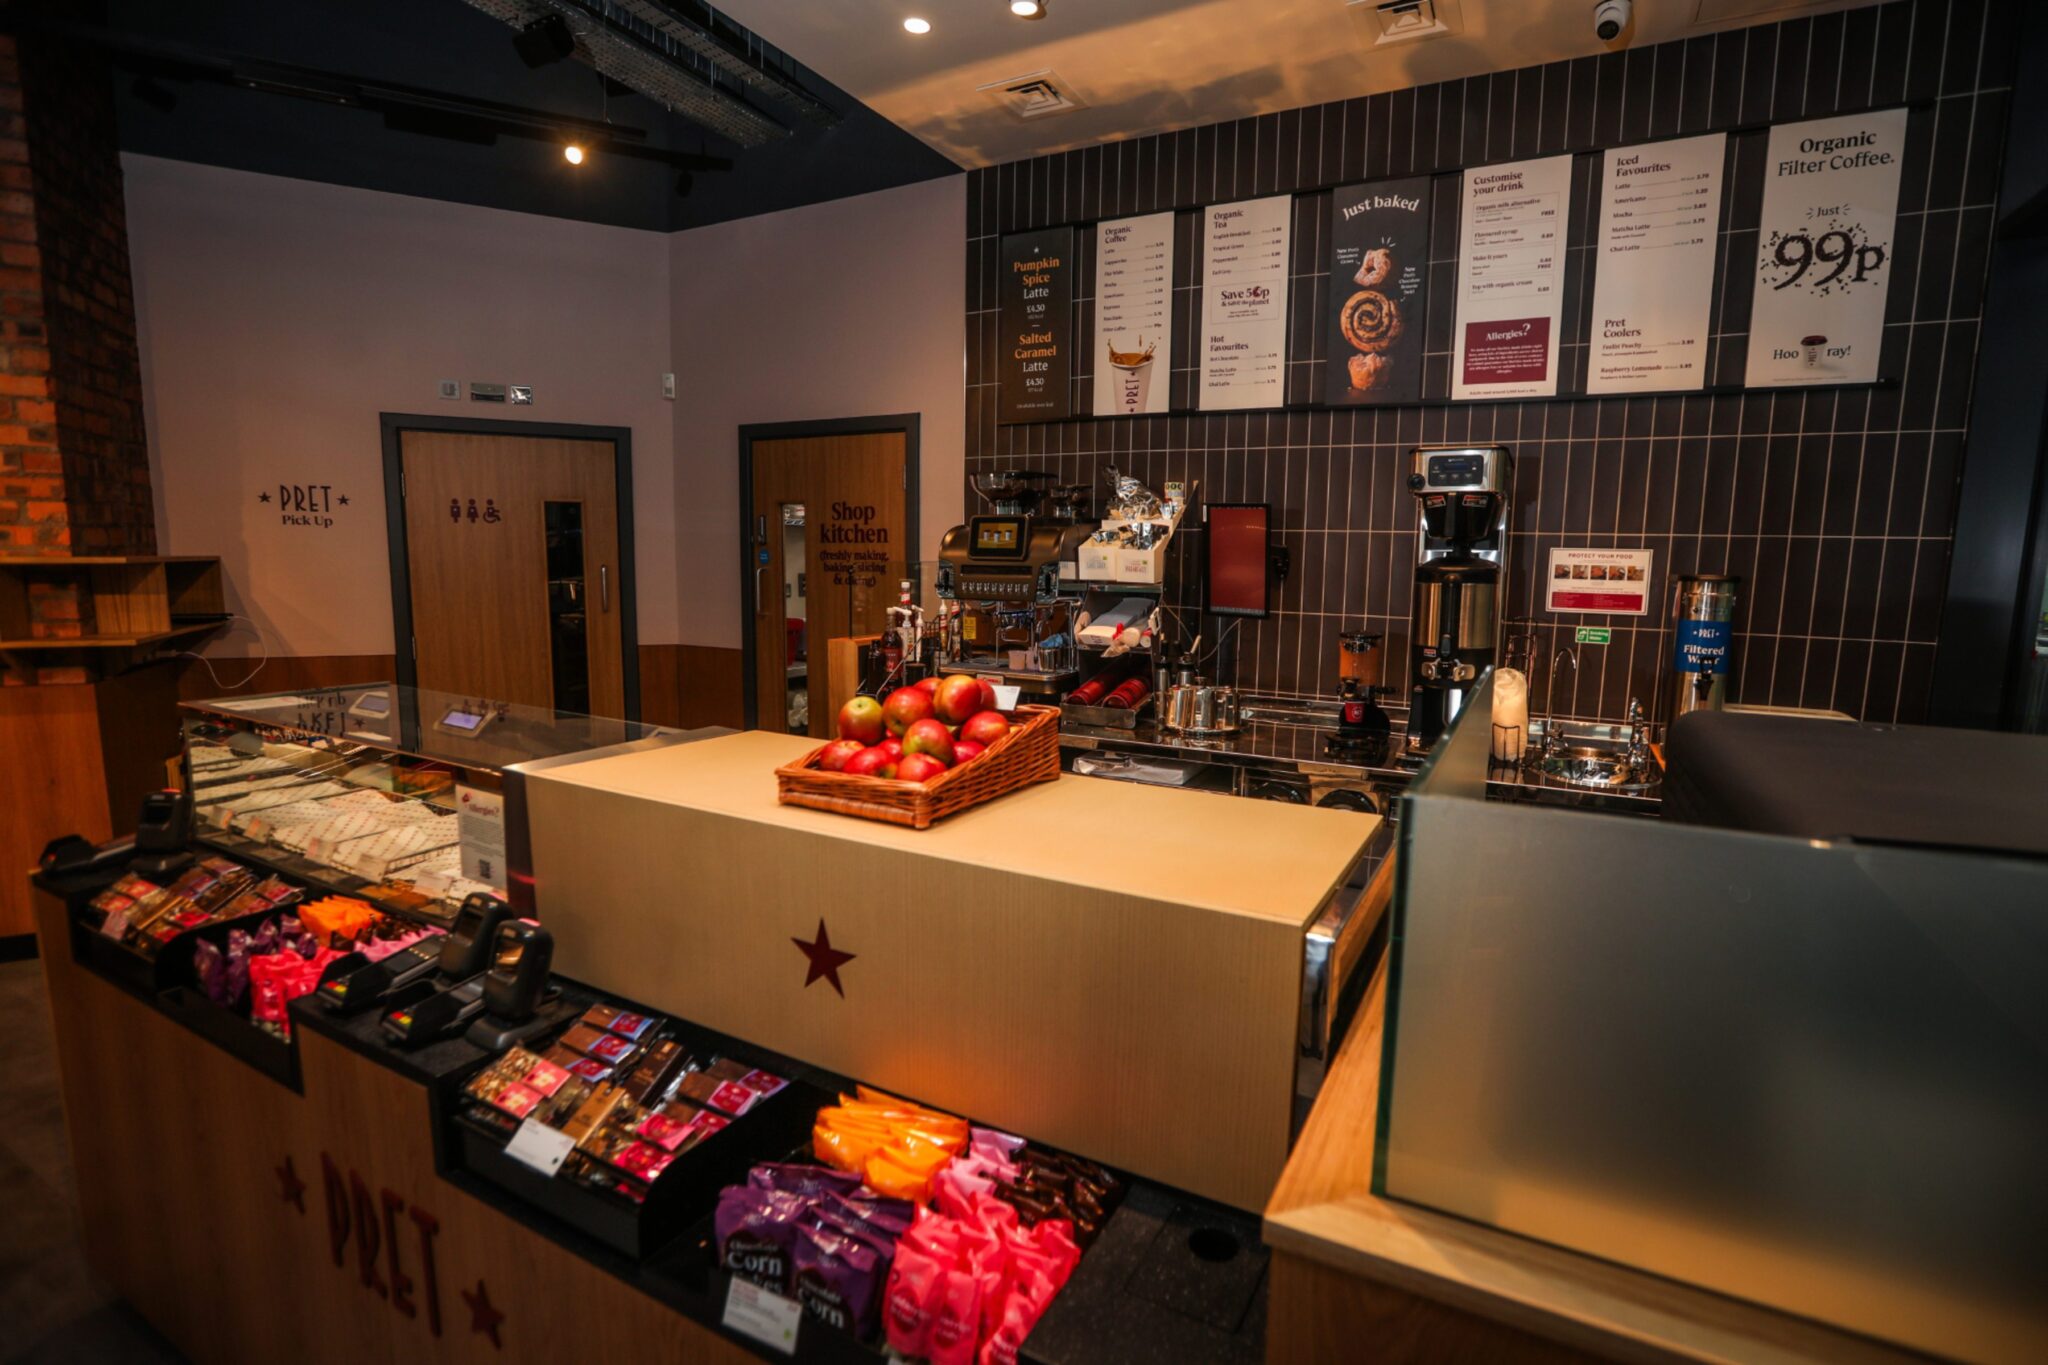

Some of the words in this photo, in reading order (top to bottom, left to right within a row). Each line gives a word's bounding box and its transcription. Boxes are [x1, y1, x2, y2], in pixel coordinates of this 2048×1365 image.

[1800, 131, 1877, 154] Organic
[1617, 155, 1639, 166] Iced
[1778, 159, 1826, 176] Filter
[1830, 152, 1896, 170] Coffee.
[1616, 163, 1672, 177] Favourites
[1473, 171, 1523, 185] Customise
[1473, 186, 1496, 198] your
[1497, 181, 1524, 192] drink
[1214, 209, 1244, 220] Organic
[1342, 198, 1372, 221] Just
[1374, 194, 1420, 212] baked
[1816, 205, 1840, 218] Just
[1105, 225, 1132, 236] Organic
[1214, 221, 1227, 229] Tea
[1105, 235, 1127, 244] Coffee
[1013, 256, 1060, 273] Pumpkin
[1774, 230, 1885, 291] 99p
[1022, 272, 1050, 287] Spice
[1023, 287, 1049, 300] Latte
[1221, 289, 1244, 300] Save
[1605, 319, 1625, 328] Pret
[1019, 331, 1052, 345] Salted
[1603, 328, 1641, 338] Coolers
[1014, 345, 1057, 359] Caramel
[1210, 342, 1249, 352] Favourites
[1773, 349, 1799, 360] Hoo
[1827, 345, 1851, 358] ray!
[1023, 361, 1049, 373] Latte
[1125, 379, 1139, 404] PRET
[279, 484, 332, 512] PRET
[832, 501, 875, 525] Shop
[282, 514, 311, 526] Pick
[314, 516, 333, 528] Up
[820, 523, 888, 543] kitchen
[1699, 628, 1715, 638] PRET
[1683, 644, 1725, 655] Filtered
[320, 1151, 442, 1339] PRET
[727, 1251, 783, 1276] Corn
